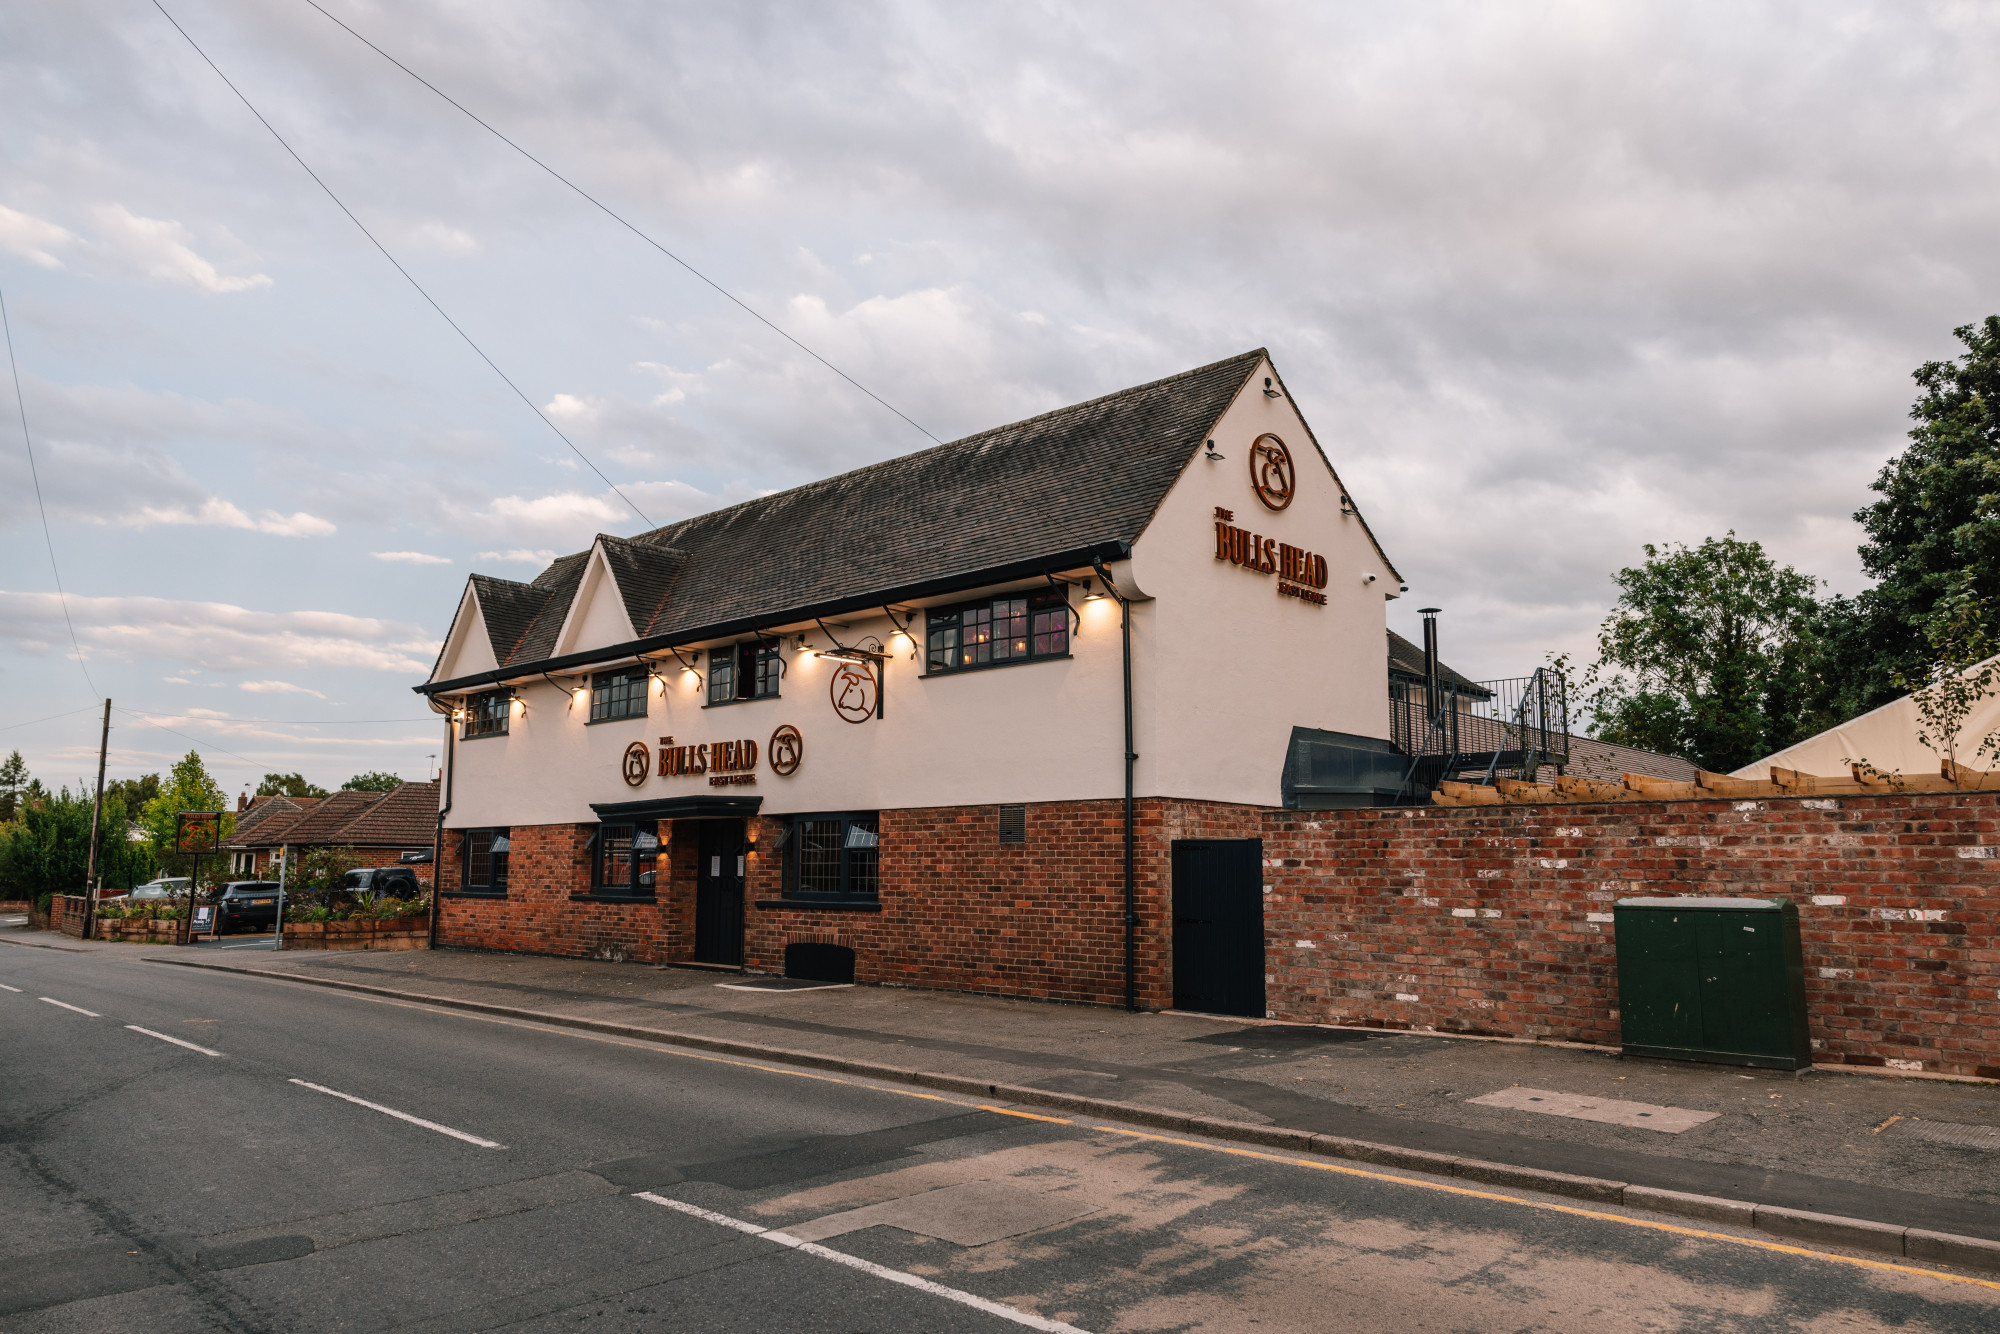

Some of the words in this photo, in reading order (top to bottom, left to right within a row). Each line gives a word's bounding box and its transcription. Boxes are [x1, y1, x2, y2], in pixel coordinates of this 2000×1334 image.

[1214, 506, 1234, 521] THE
[1214, 522, 1277, 575] BULLS
[1279, 543, 1329, 590] HEAD
[1279, 581, 1301, 597] EAST
[1301, 588, 1328, 606] LEAKE
[659, 736, 674, 746] THE
[657, 743, 708, 777] BULLS
[709, 739, 758, 773] HEAD
[709, 776, 728, 786] EAST
[729, 774, 756, 785] LEAKE
